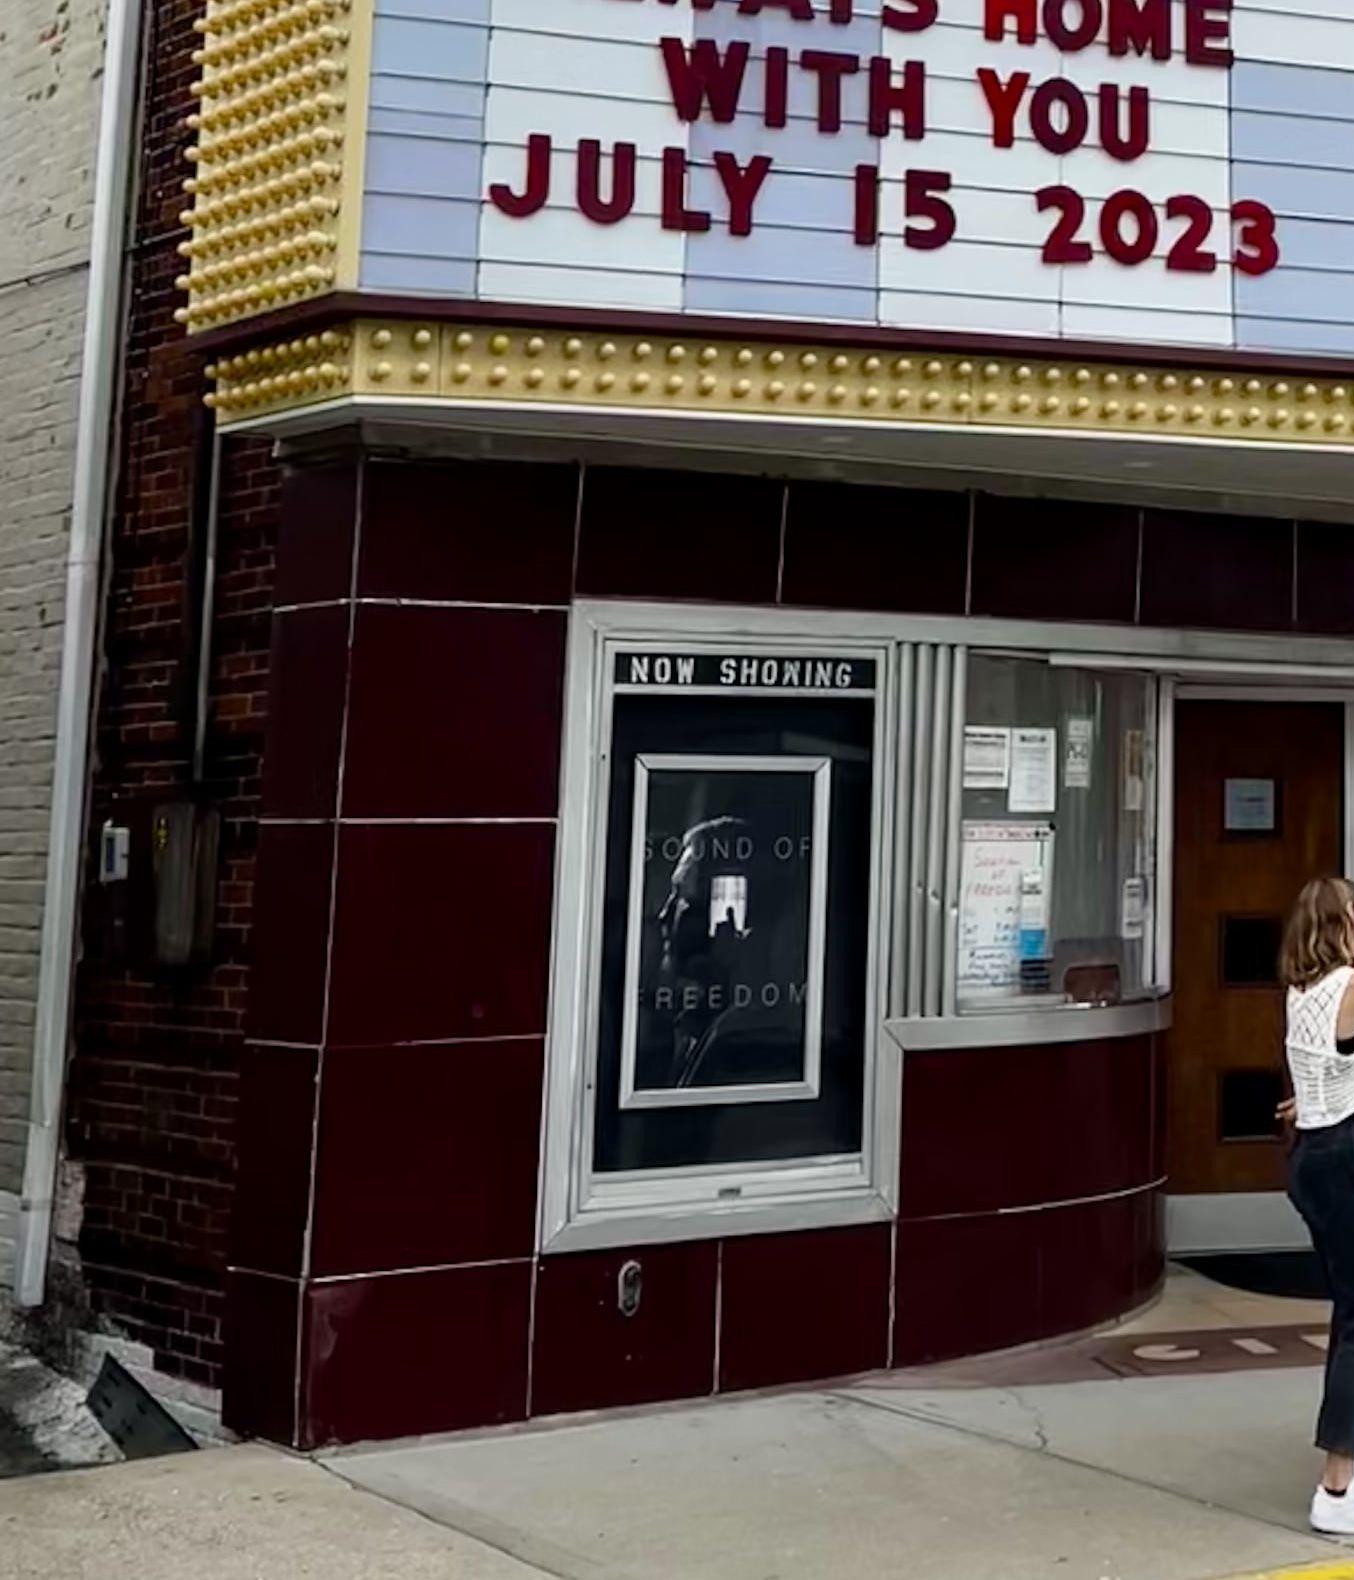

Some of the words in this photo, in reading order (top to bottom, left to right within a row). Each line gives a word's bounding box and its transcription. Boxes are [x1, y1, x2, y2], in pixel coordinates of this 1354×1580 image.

[984, 0, 1234, 67] HOME
[660, 37, 925, 140] WITH
[976, 67, 1149, 161] YOU
[489, 133, 773, 237] JULY
[853, 164, 957, 251] 15
[1036, 185, 1281, 276] 2023
[630, 656, 695, 684] NOW
[719, 658, 853, 688] SHOWING
[773, 836, 811, 860] OF
[638, 982, 808, 1010] REEDOM
